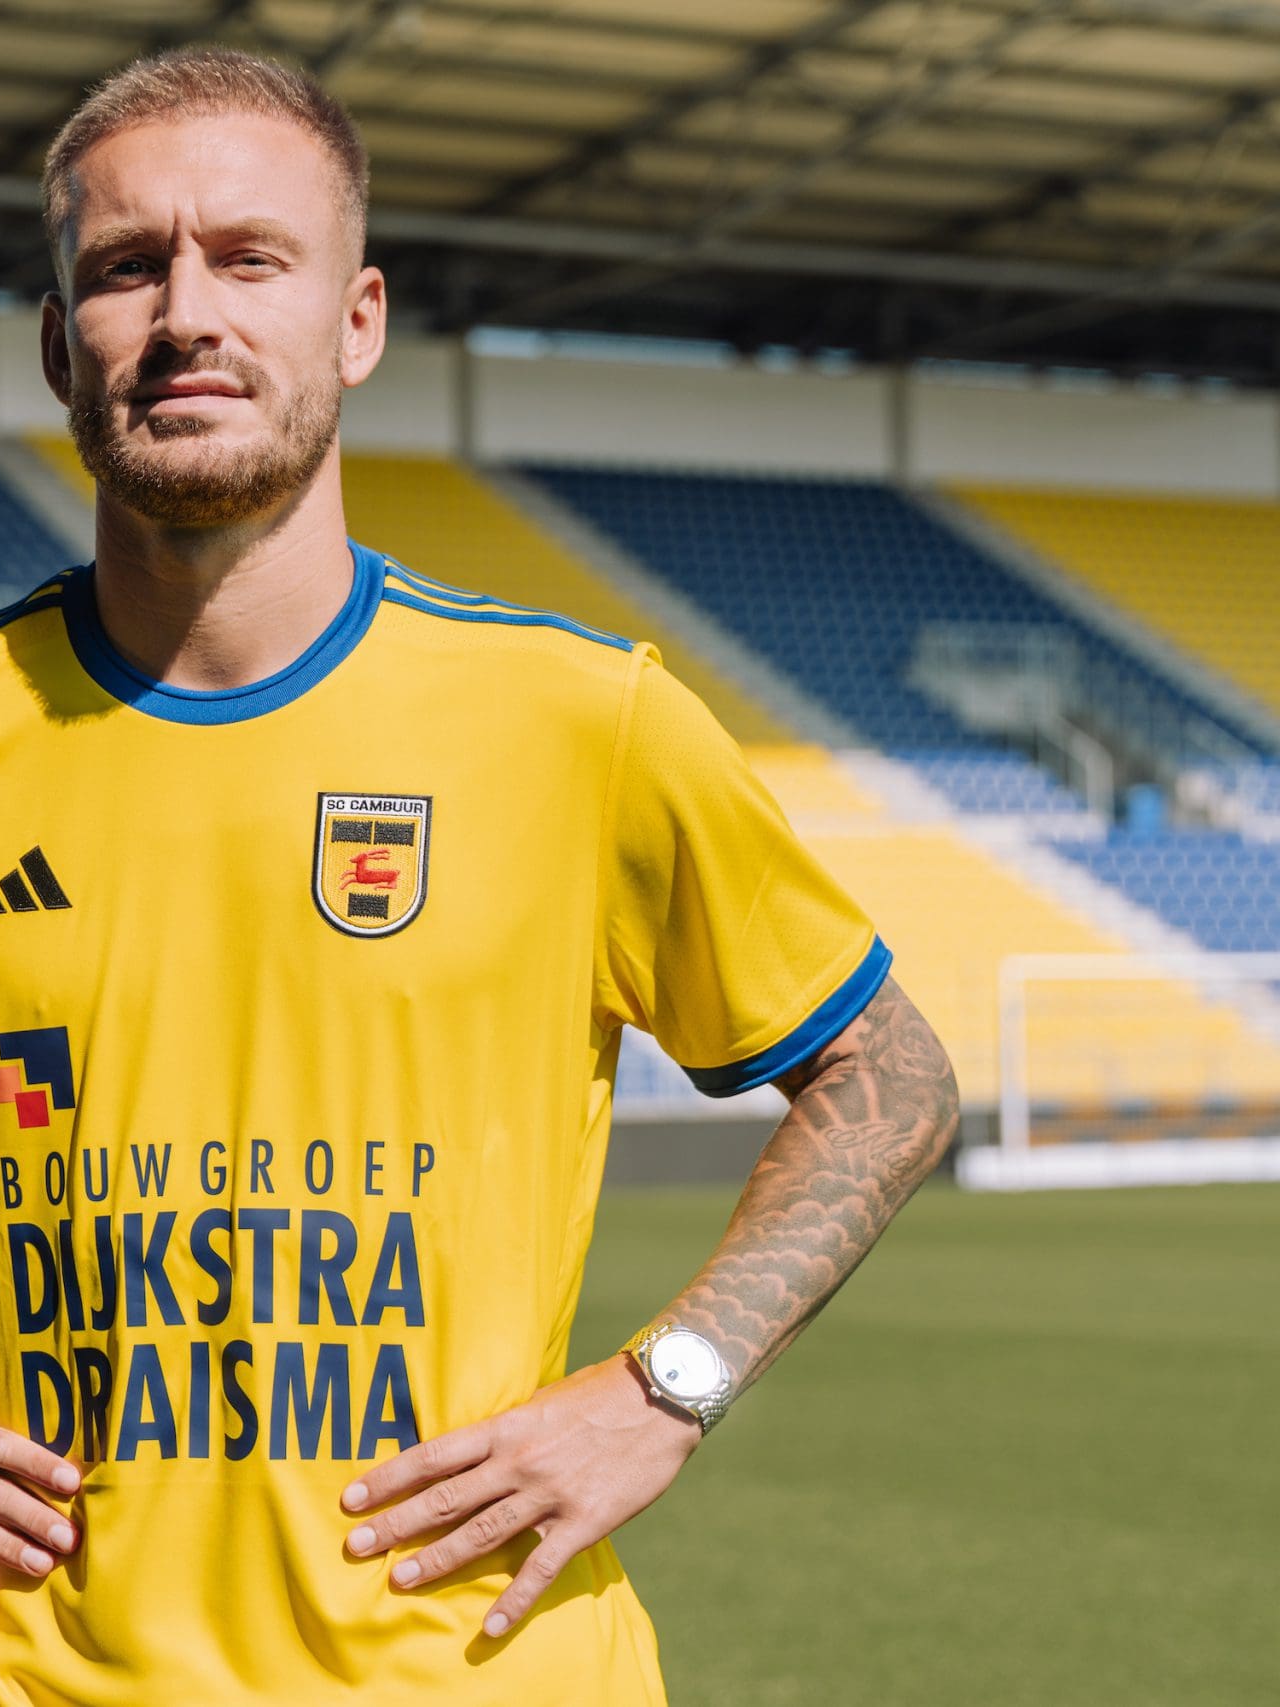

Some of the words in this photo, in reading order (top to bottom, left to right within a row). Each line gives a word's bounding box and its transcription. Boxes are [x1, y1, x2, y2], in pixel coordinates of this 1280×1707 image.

[327, 799, 345, 810] SC
[350, 800, 423, 814] CAMBUUR
[1, 1139, 435, 1209] BOUWGROEP
[8, 1208, 425, 1334] DIJKSTRA
[21, 1340, 419, 1462] DRAISMA
